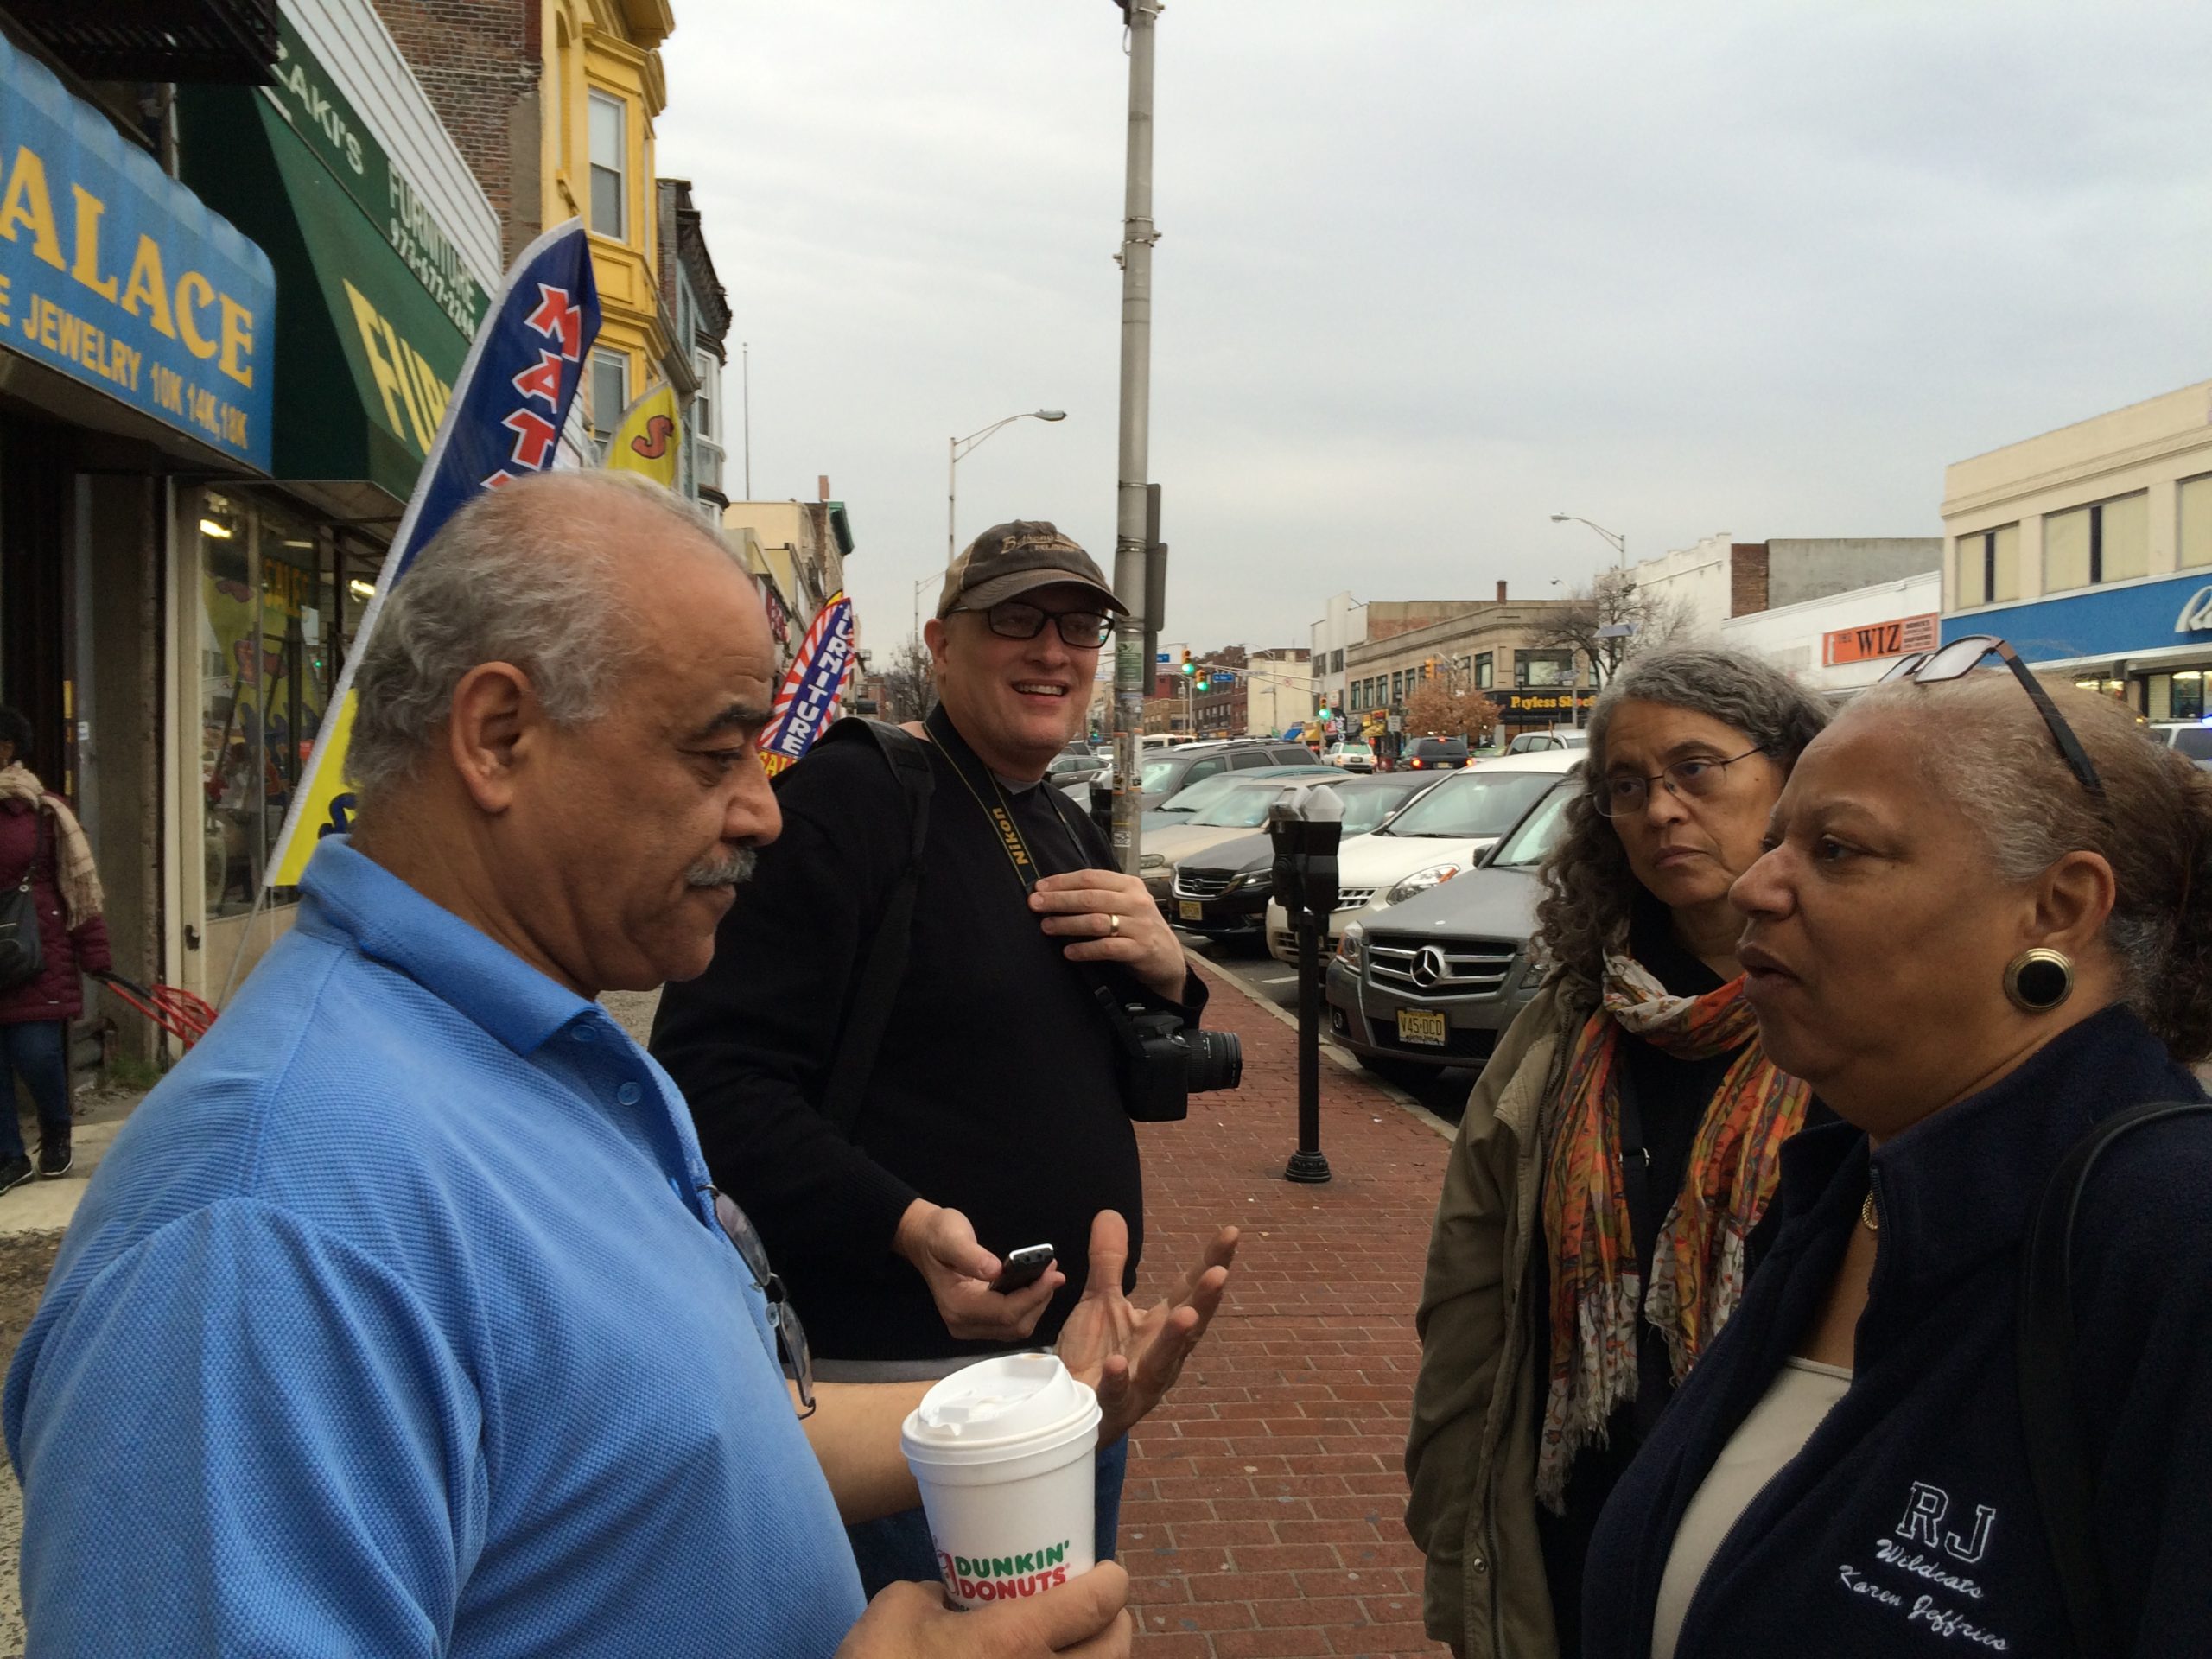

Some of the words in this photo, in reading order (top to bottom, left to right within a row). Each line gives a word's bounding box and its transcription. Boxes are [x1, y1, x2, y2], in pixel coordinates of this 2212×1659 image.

[0, 144, 253, 389] ALACE
[388, 158, 475, 315] FURNITURE
[22, 292, 142, 391] JEWELRY
[149, 361, 183, 416] 10K
[480, 283, 582, 490] MAT
[781, 604, 851, 755] FURNITURE
[1856, 624, 1900, 656] WIZ
[760, 751, 797, 776] SAL
[992, 807, 1029, 865] Nikon
[954, 1540, 1070, 1579] DUNKIN'
[1895, 1480, 1996, 1563] RJ
[959, 1566, 1066, 1601] DONUTS
[1839, 1564, 1902, 1607] Karen
[1907, 1595, 2009, 1650] Jeffries
[1875, 1538, 1983, 1599] Wildcats
